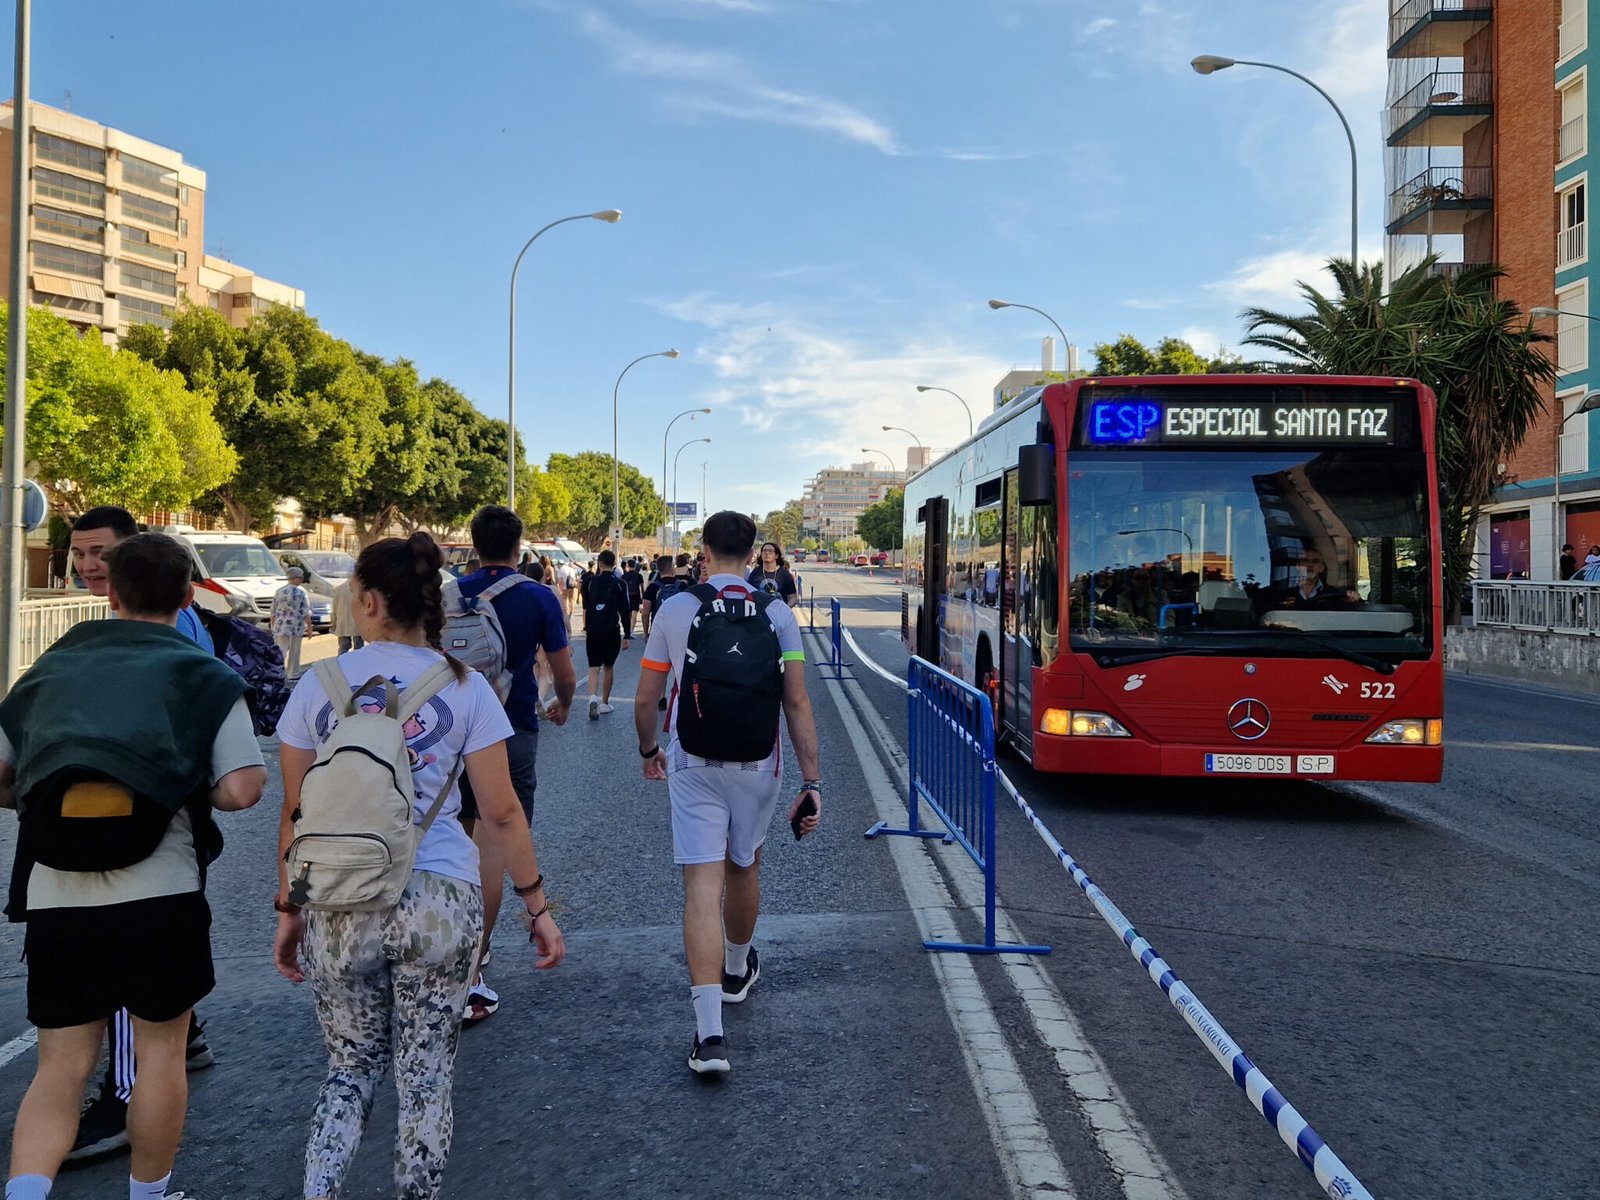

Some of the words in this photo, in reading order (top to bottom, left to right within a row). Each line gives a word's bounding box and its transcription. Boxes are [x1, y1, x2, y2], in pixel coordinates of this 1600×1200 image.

[1094, 404, 1159, 438] ESP
[1166, 408, 1268, 436] ESPECIAL
[1274, 408, 1341, 436] SANTA
[1348, 408, 1388, 436] FAZ
[1360, 682, 1396, 698] 522
[1217, 756, 1252, 769] 5096
[1302, 757, 1329, 771] SP
